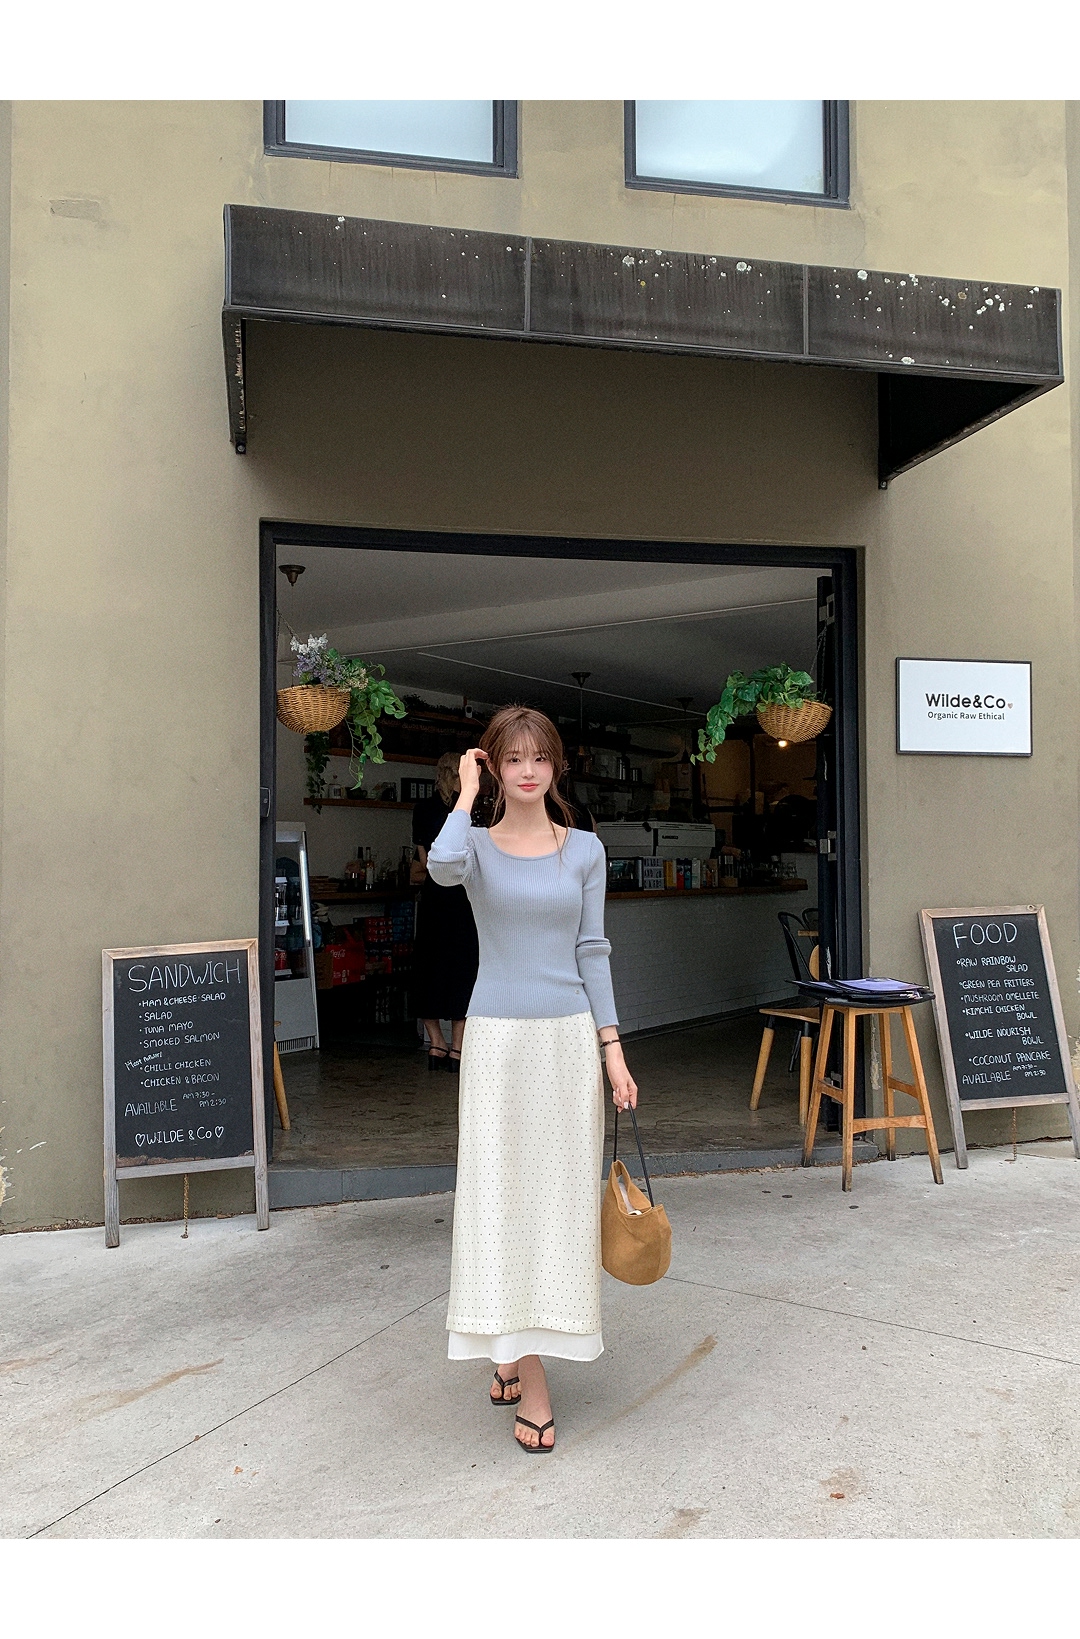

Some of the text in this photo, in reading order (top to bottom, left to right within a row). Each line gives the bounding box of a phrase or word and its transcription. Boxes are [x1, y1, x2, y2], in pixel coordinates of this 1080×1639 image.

[926, 694, 1006, 708] Wilde&Co
[928, 712, 958, 720] Organic
[952, 922, 1018, 948] FOOD
[960, 956, 1016, 967] RAW RAINBOW
[1006, 964, 1028, 972] SALAD
[128, 959, 240, 992] SANDWICH
[962, 979, 1034, 989] GREEN PEA FRITTERS
[142, 999, 162, 1007] HAM
[201, 992, 226, 1002] SALAD
[964, 991, 1039, 1003] MUSHROOM OMELLETE
[966, 1004, 1025, 1015] KIMCHI CHICKEN
[1017, 1012, 1037, 1020] BOWL
[144, 1012, 172, 1021] SALAD
[144, 1021, 193, 1035] TUNA MAYO
[969, 1027, 1031, 1040] WILDE NOURISH
[144, 1032, 220, 1049] SMOKED SALMON
[1022, 1037, 1044, 1045] BOWL
[973, 1051, 1051, 1065] COCONUT PANCAKE
[144, 1059, 211, 1073] CHILLI CHICKEN
[144, 1076, 181, 1087] CHICKEN
[962, 1071, 1011, 1084] AVAILABLE
[125, 1099, 178, 1116] AVAILABLE
[147, 1129, 184, 1144] WILDE
